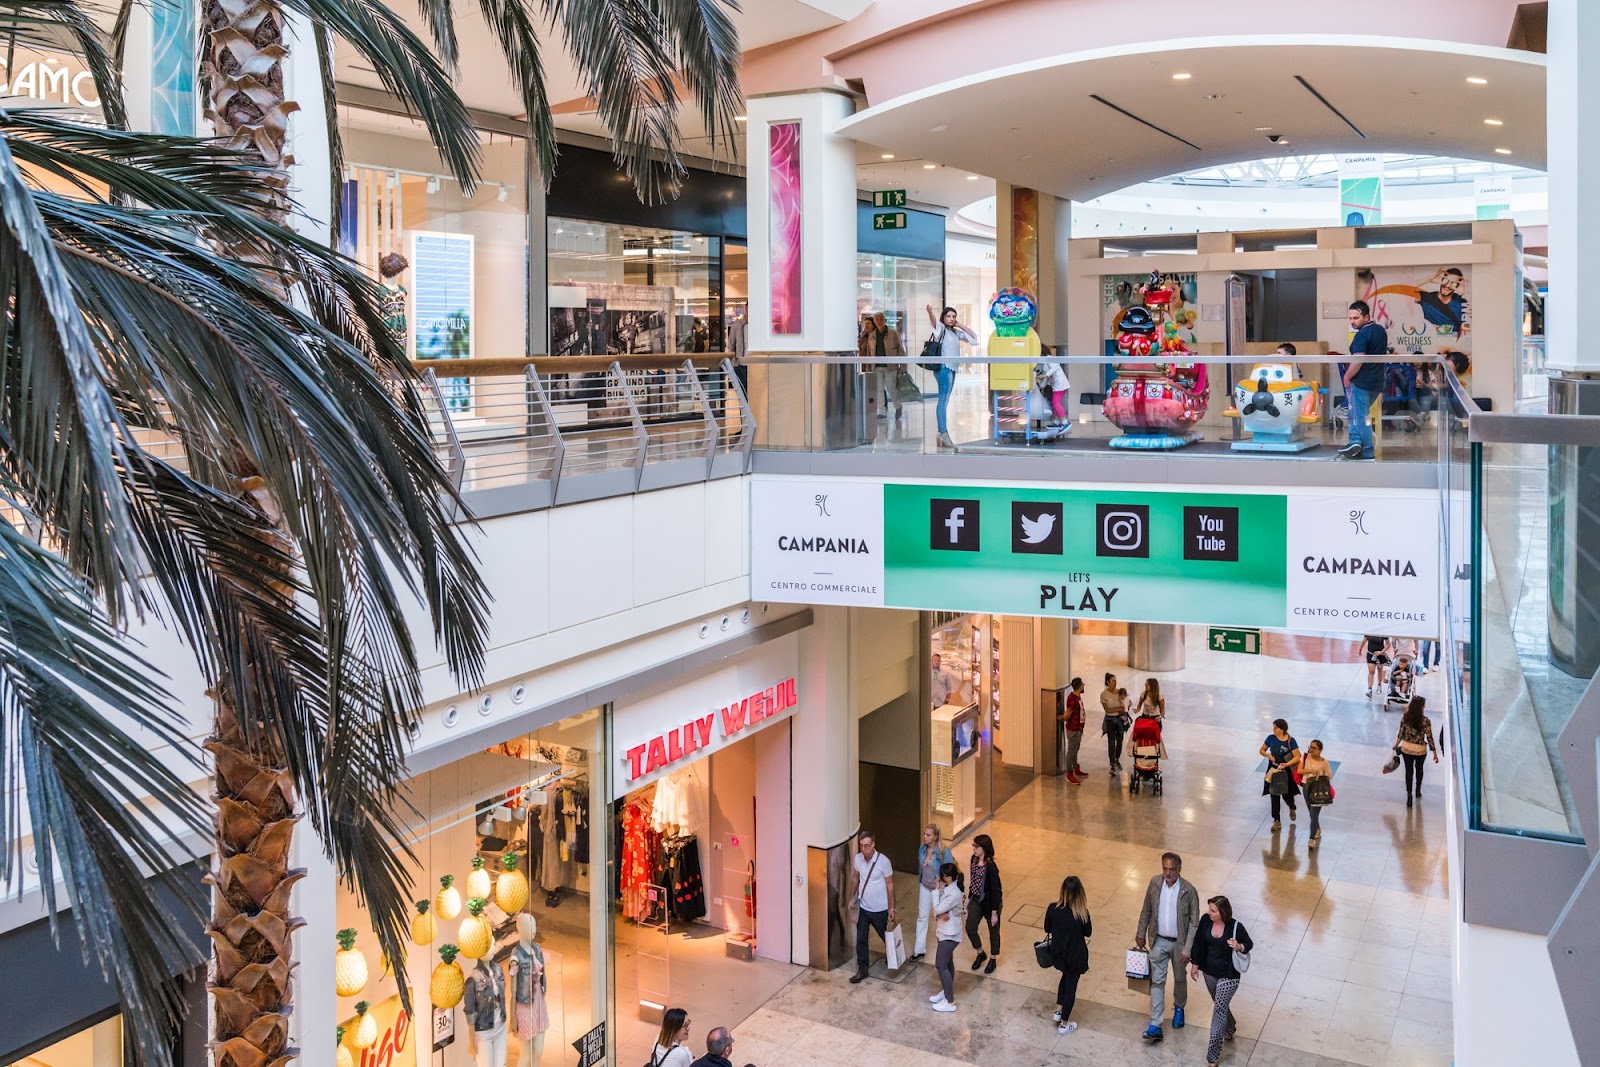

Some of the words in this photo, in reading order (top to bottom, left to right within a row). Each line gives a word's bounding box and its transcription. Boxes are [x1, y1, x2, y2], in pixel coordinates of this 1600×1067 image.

[1345, 156, 1376, 164] CAMPANIA
[1397, 336, 1432, 346] WELLNESS
[607, 378, 643, 388] GRUND
[1198, 514, 1224, 533] You
[778, 535, 870, 555] CAMPANIA
[1196, 535, 1226, 552] Tube
[1303, 556, 1417, 578] CAMPANIA
[1068, 572, 1091, 584] LET'S
[770, 581, 808, 592] CENTRO
[810, 583, 877, 595] COMMERCIALE
[1040, 584, 1119, 613] PLAY
[1293, 607, 1340, 618] CENTRO
[1343, 609, 1427, 622] COMMERCIALE
[626, 712, 715, 781] TALLY
